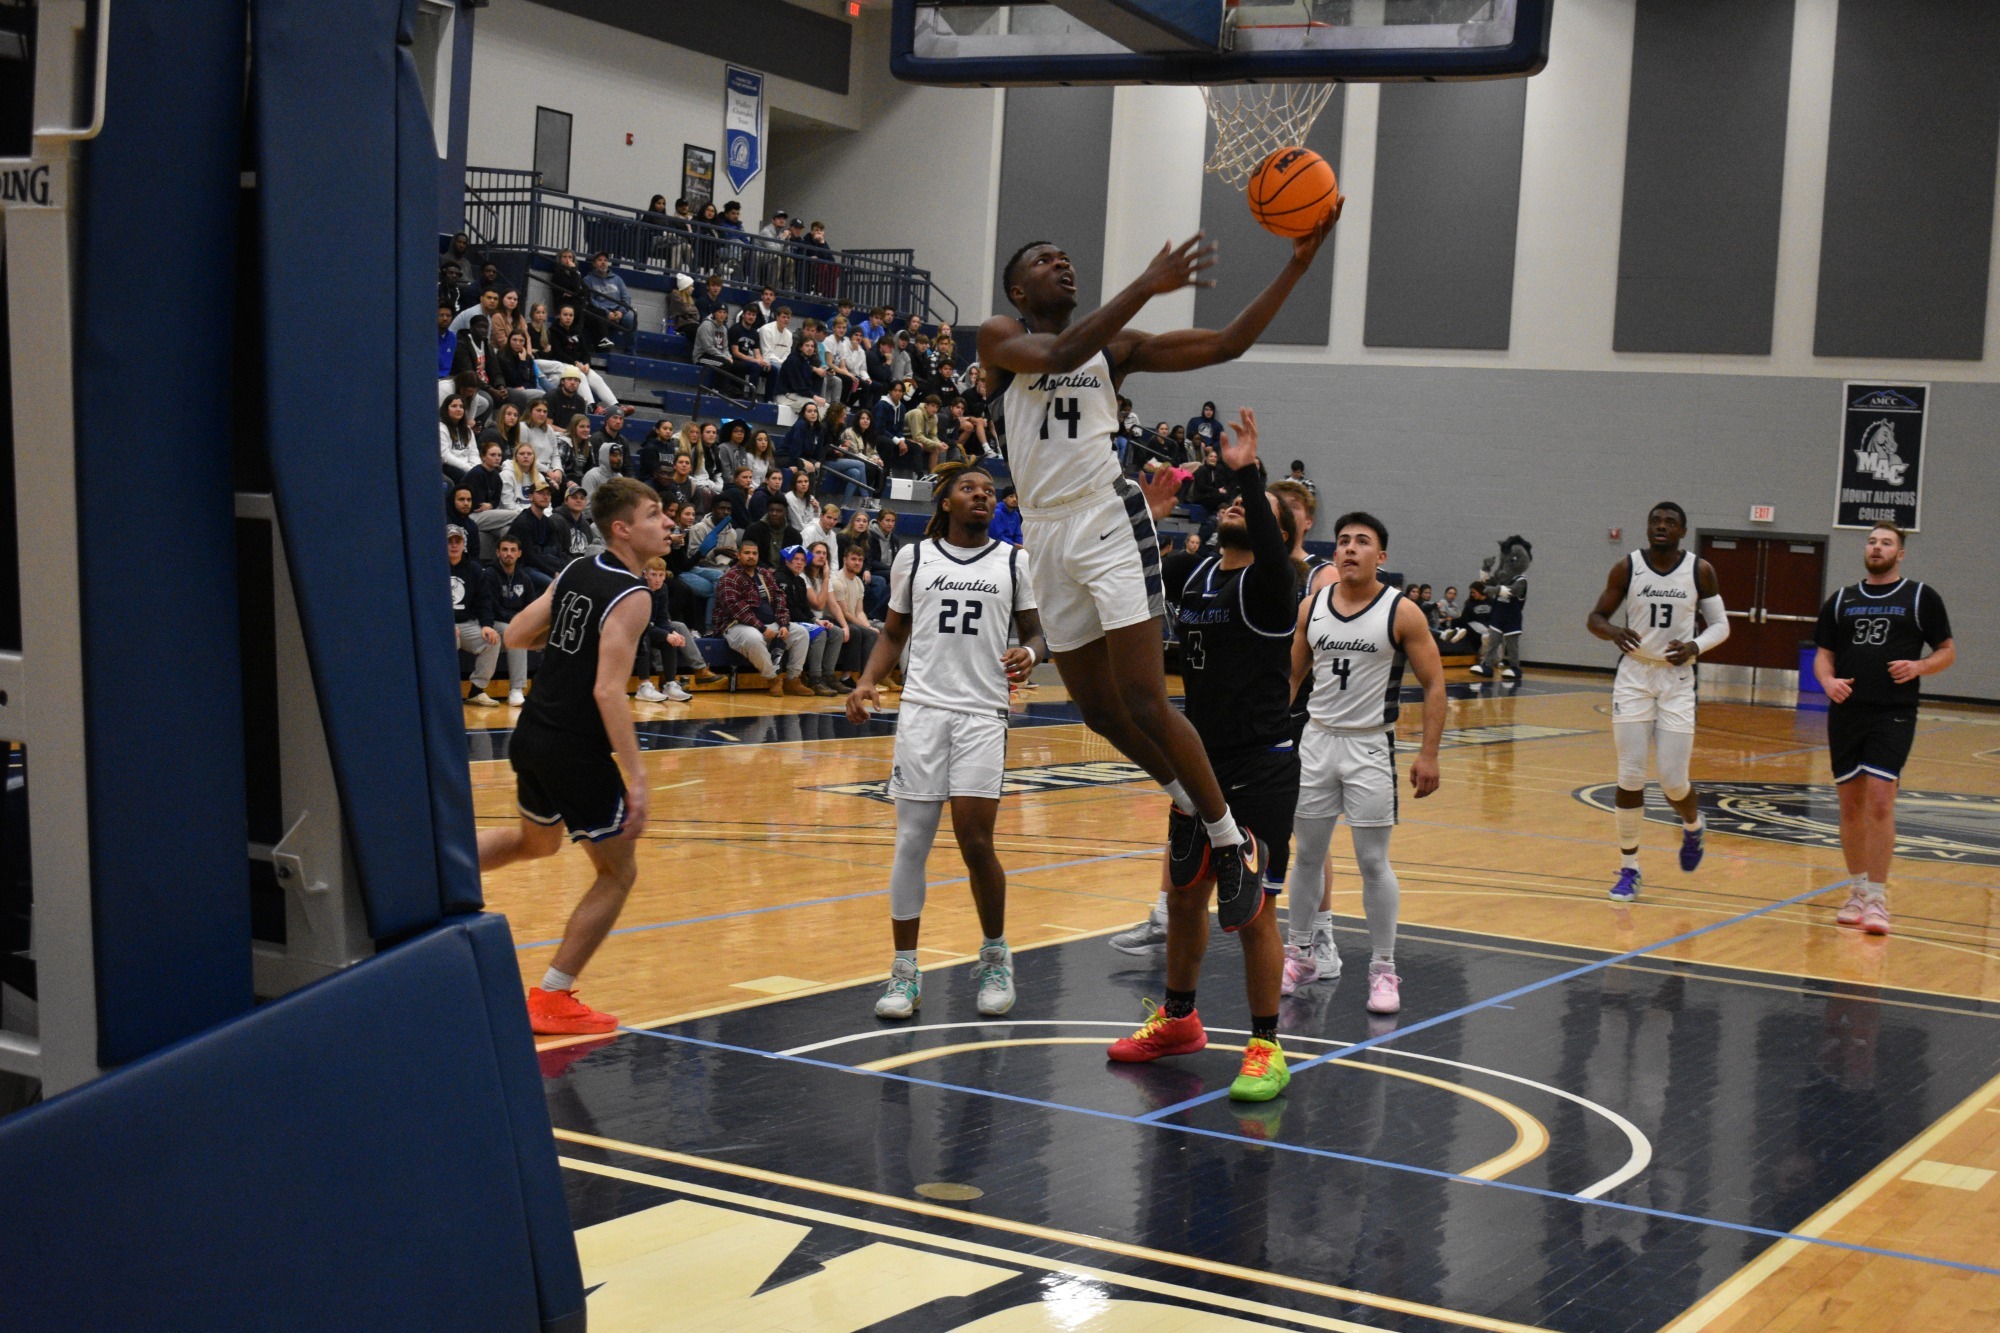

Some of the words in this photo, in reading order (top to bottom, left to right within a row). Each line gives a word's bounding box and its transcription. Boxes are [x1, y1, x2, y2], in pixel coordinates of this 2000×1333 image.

[0, 165, 50, 207] ING
[1853, 450, 1910, 487] MAC
[1841, 488, 1873, 504] MOUNT
[1873, 490, 1916, 507] ALOYSIUS
[1858, 507, 1896, 521] COLLEGE
[925, 574, 1000, 594] Mounties
[1637, 584, 1688, 599] Mounties
[548, 590, 593, 655] 13
[938, 598, 983, 636] 22
[1650, 603, 1673, 629] 13
[1313, 633, 1379, 653] Mounties
[1852, 617, 1891, 646] 33
[1332, 657, 1351, 691] 4
